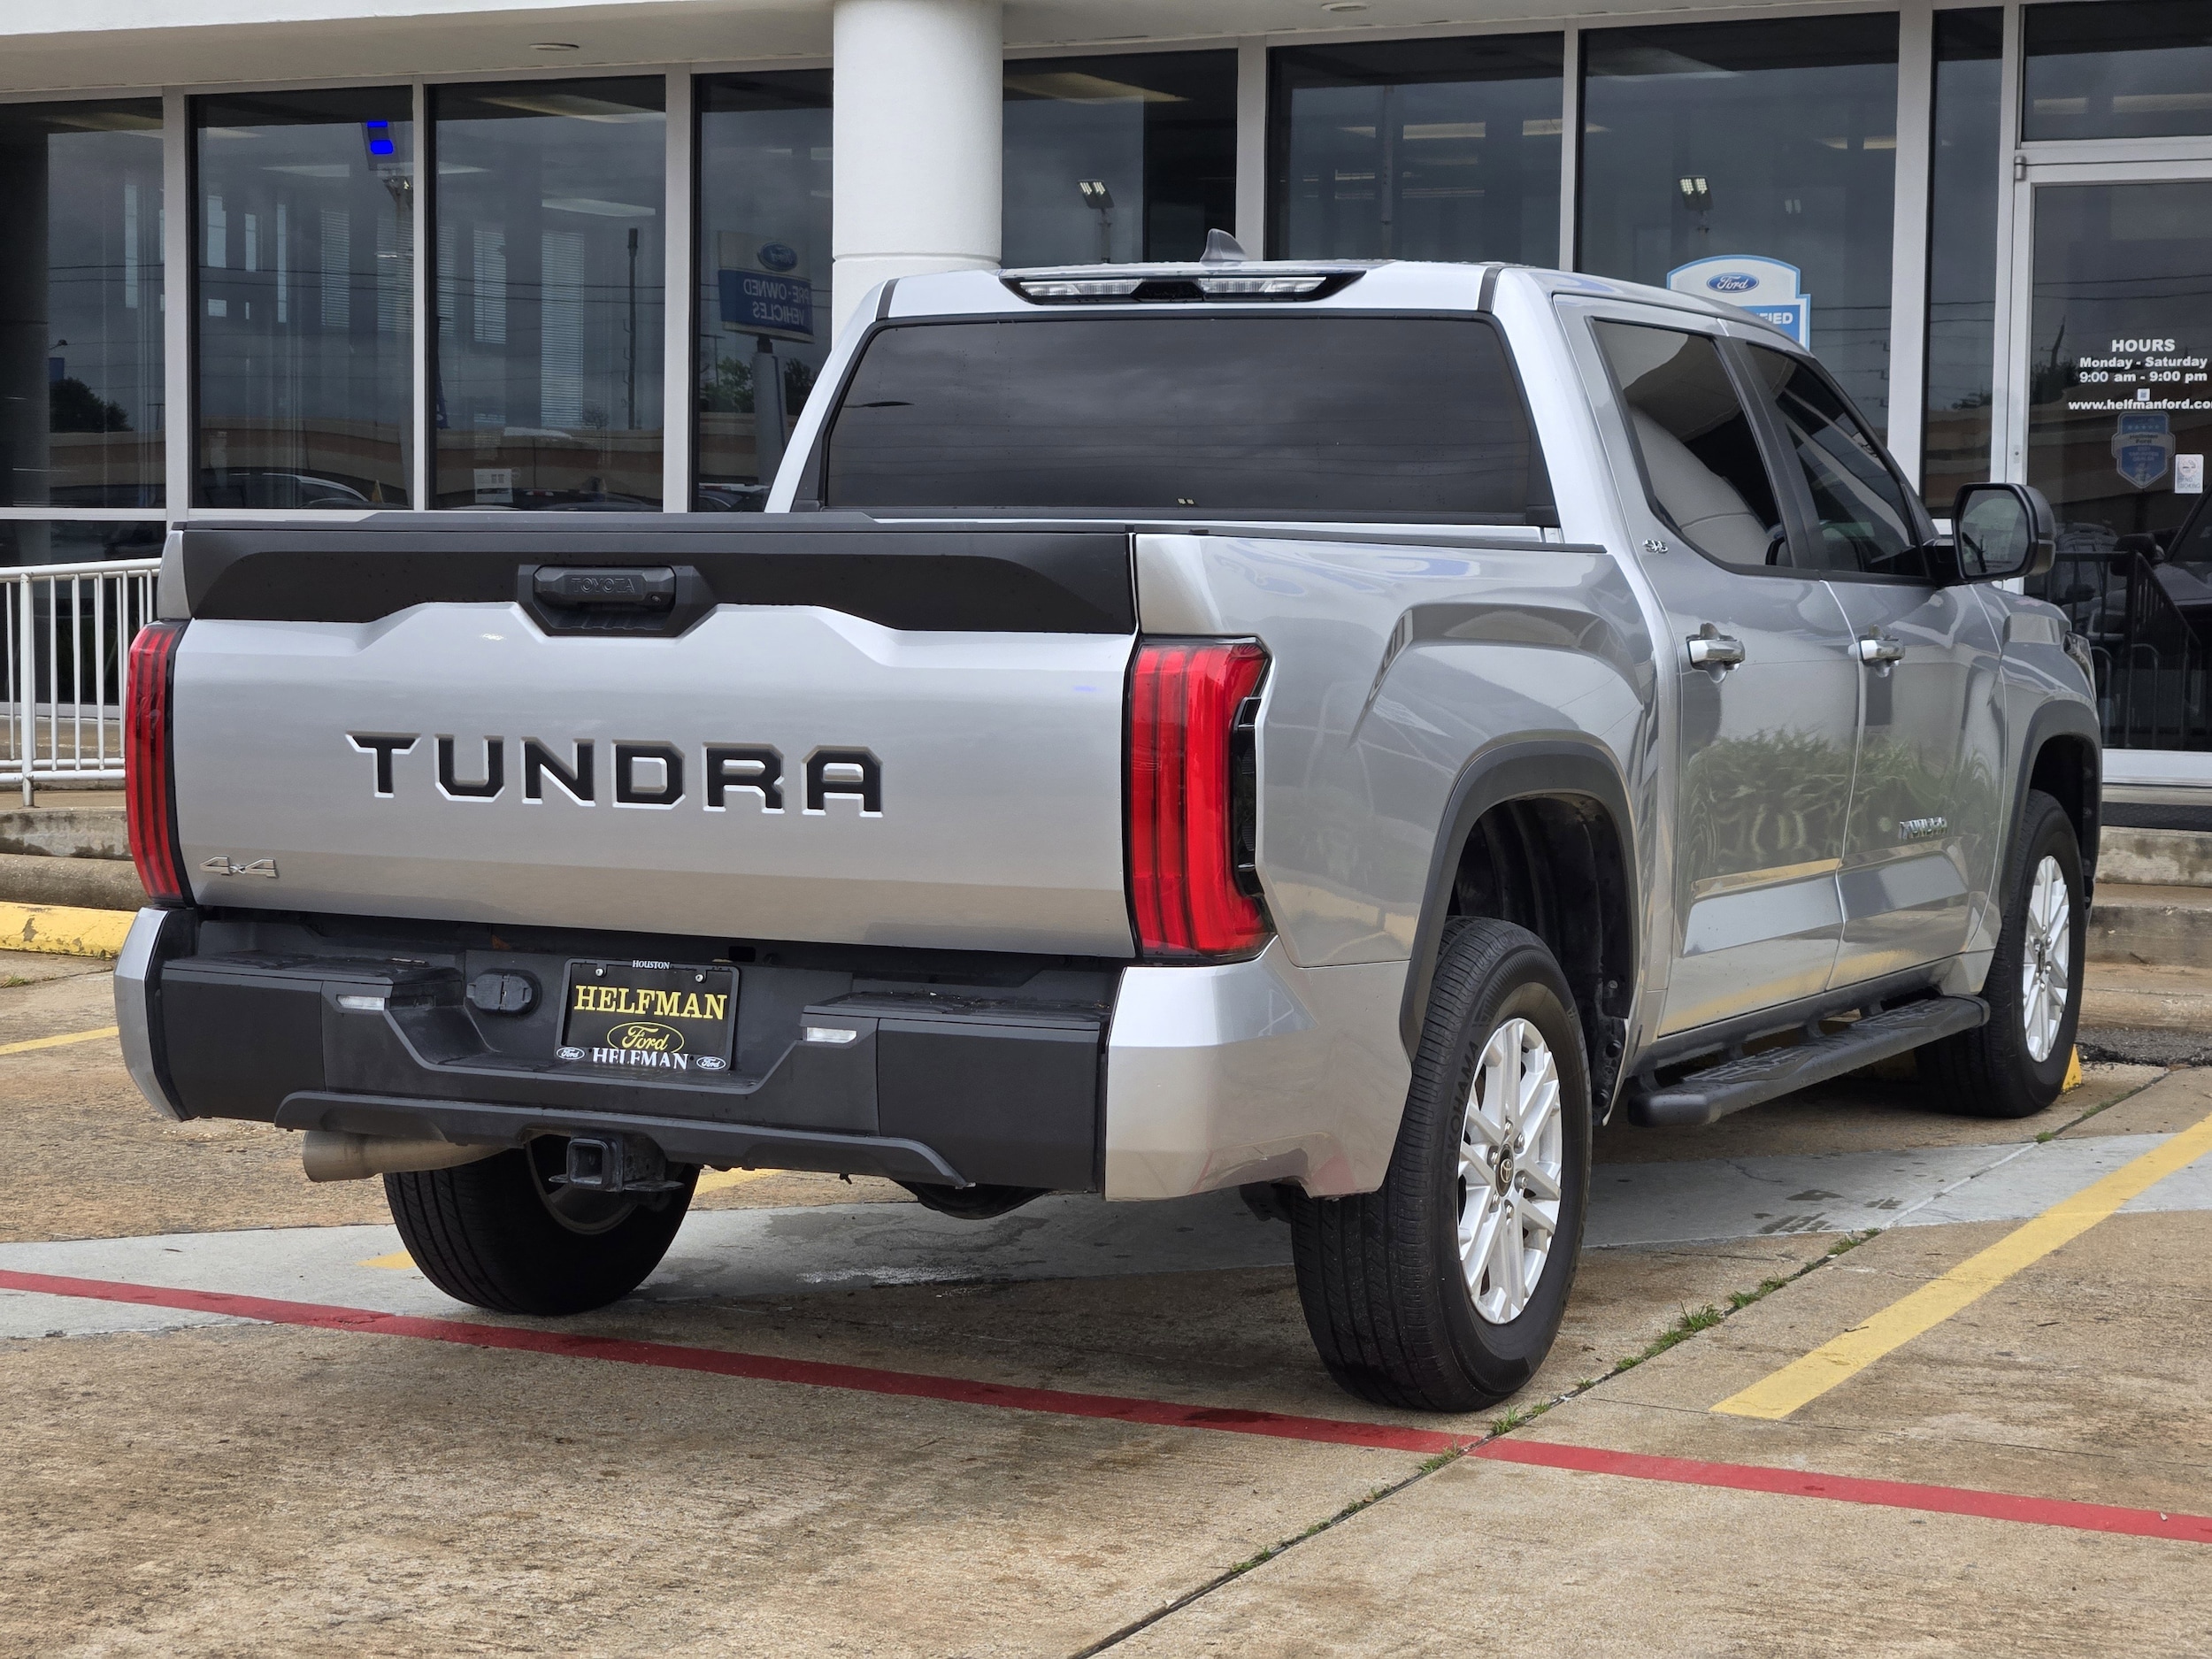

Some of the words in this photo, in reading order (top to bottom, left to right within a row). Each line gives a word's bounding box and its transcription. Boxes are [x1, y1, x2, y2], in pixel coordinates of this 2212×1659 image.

[1717, 275, 1748, 290] Ford
[2111, 339, 2176, 352] HOURS
[2079, 357, 2133, 370] Monday
[2145, 356, 2208, 369] Saturday
[2079, 371, 2109, 383] 9:00
[2114, 373, 2137, 382] am
[2149, 371, 2181, 382] 9:00
[2185, 373, 2208, 384] pm
[2068, 398, 2212, 410] www.helfmanford.co
[571, 578, 636, 594] TOYOTA
[345, 731, 883, 818] TUNDRA
[632, 959, 671, 970] HOUSTON
[573, 984, 728, 1020] HELFMAN
[621, 1025, 670, 1051] Ford
[592, 1047, 689, 1070] HELFMAN
